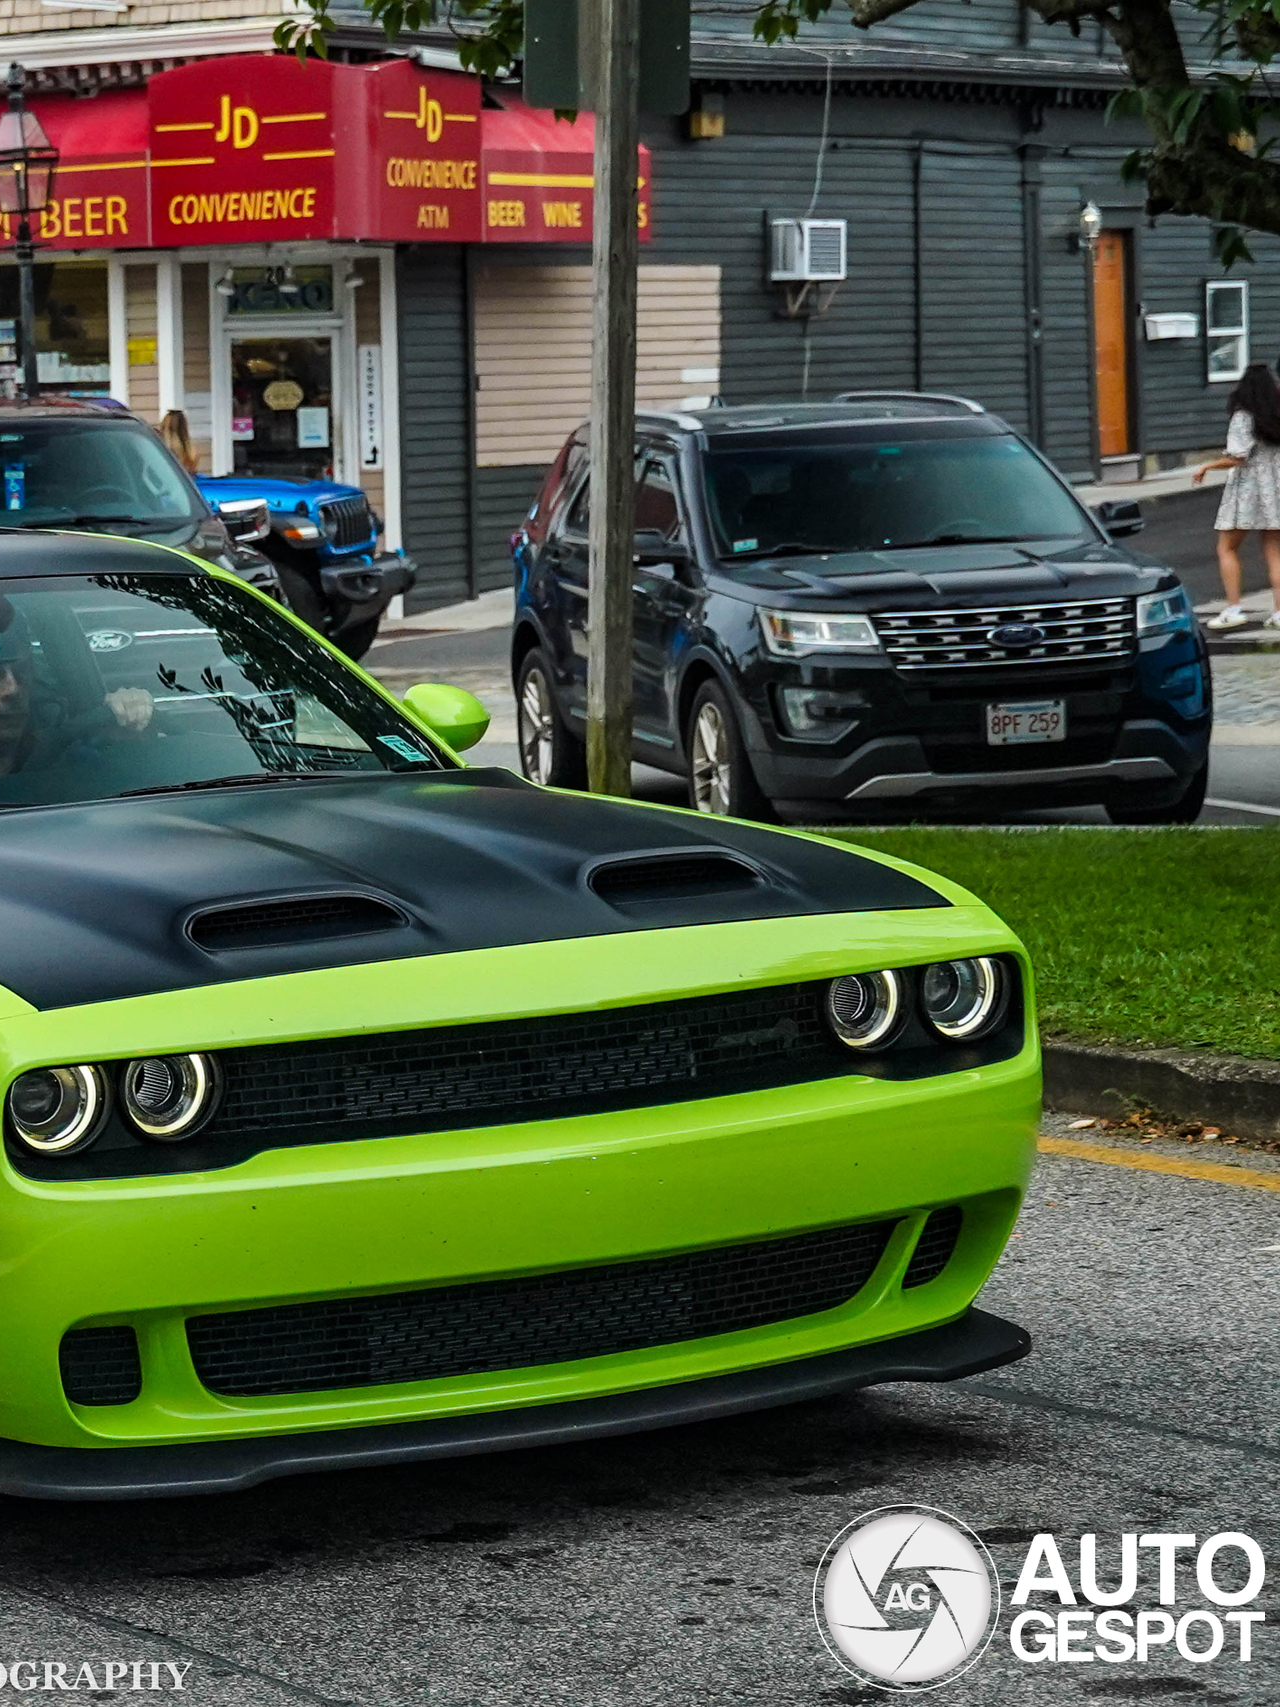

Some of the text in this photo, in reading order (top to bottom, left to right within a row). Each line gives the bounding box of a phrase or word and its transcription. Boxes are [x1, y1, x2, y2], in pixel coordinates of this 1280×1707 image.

[215, 94, 259, 149] JD
[416, 85, 443, 143] JD
[386, 156, 477, 190] CONVENIENCE
[39, 195, 129, 239] BEER
[168, 187, 317, 226] CONVENIENCE
[417, 205, 450, 229] ATM
[487, 200, 583, 228] BEER WINE
[1028, 712, 1060, 733] 259
